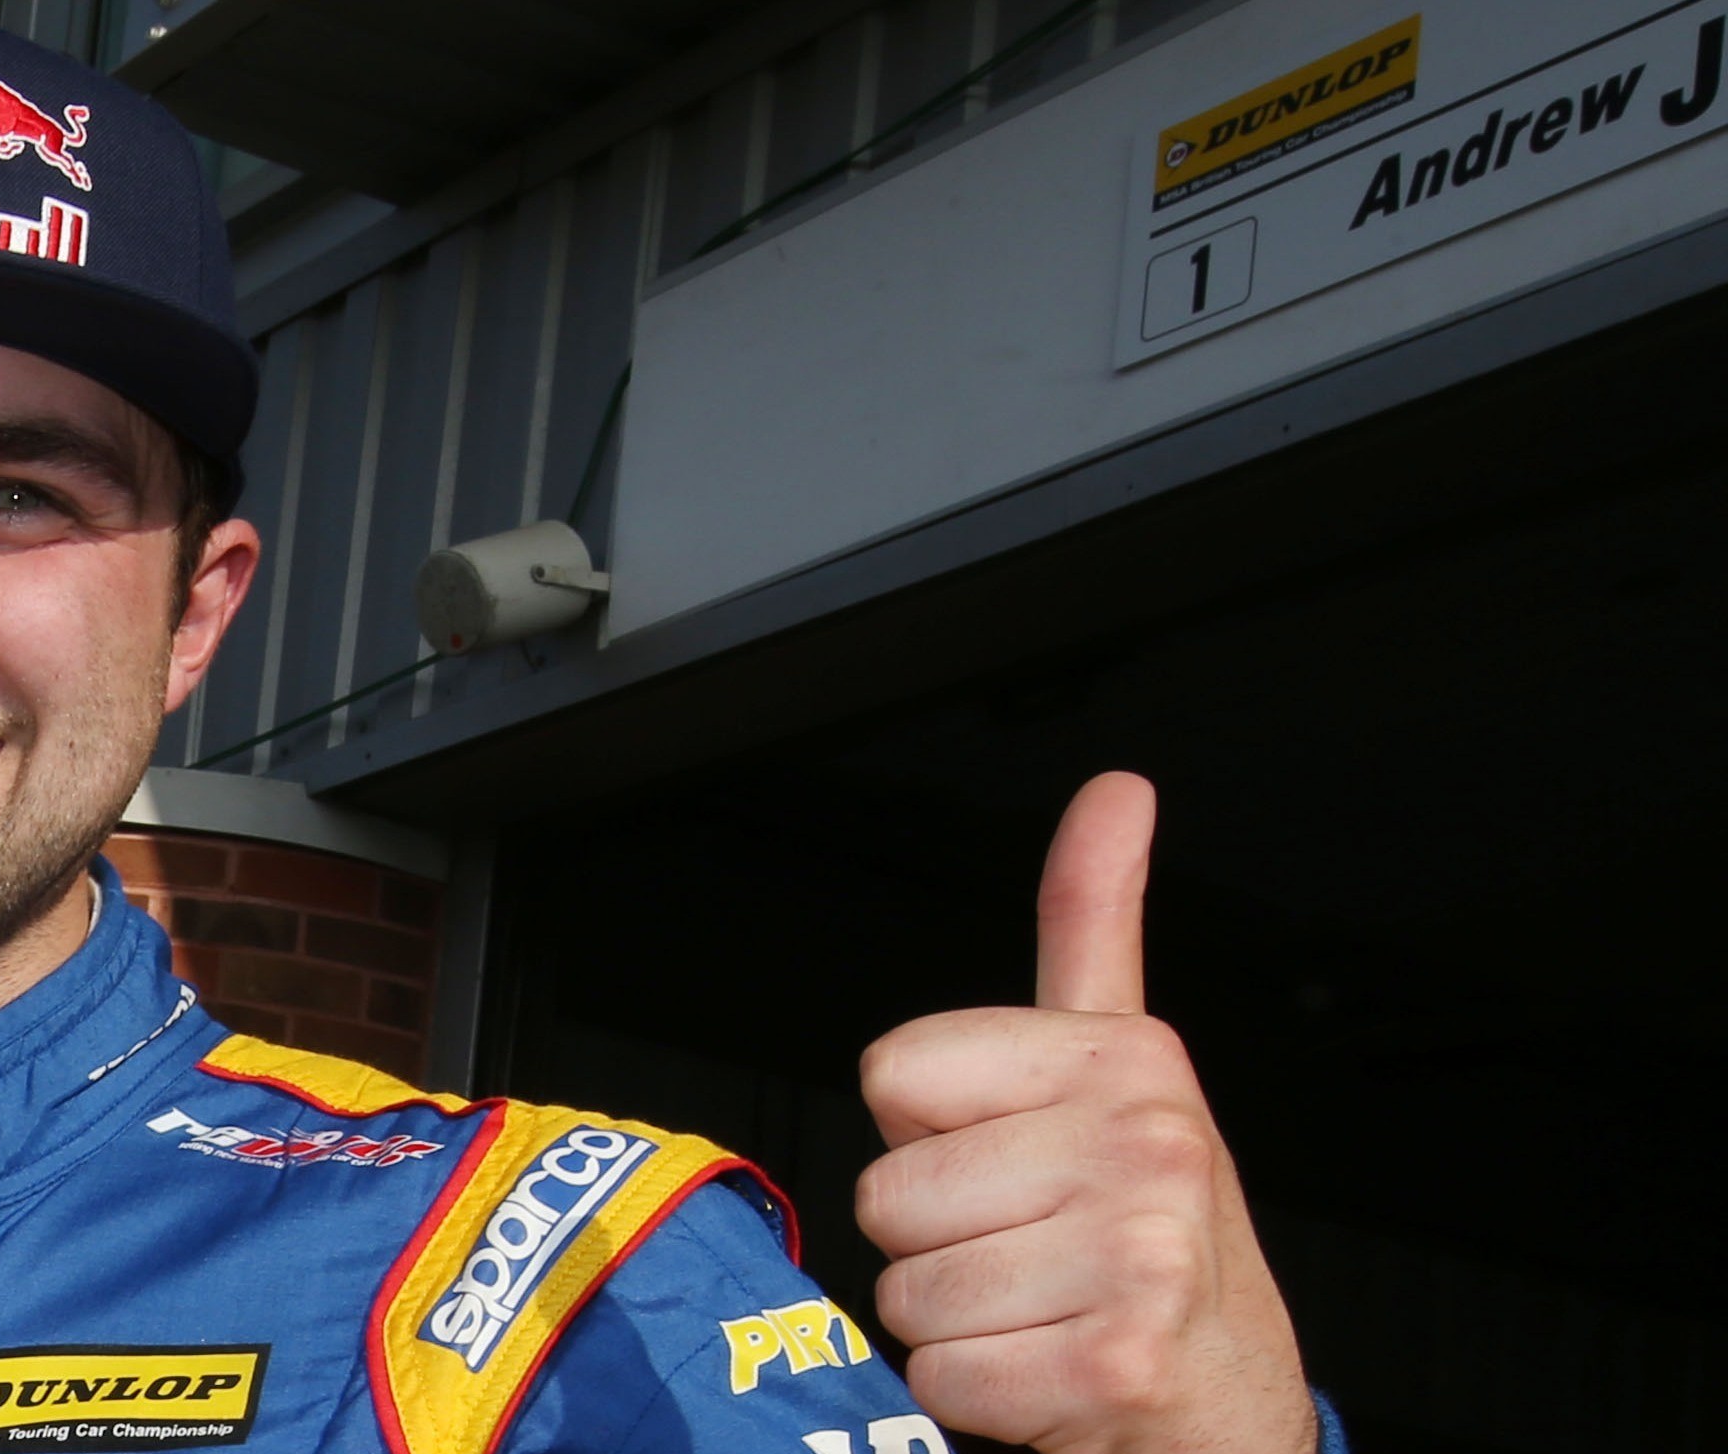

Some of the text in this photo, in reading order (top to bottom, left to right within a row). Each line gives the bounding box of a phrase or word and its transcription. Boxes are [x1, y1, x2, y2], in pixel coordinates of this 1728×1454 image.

[1200, 36, 1414, 153] DUNLOP
[1348, 63, 1647, 231] Andrew
[1190, 243, 1212, 315] 1
[430, 1126, 627, 1352] sparco
[7, 1424, 70, 1442] Touring
[75, 1422, 108, 1438] Car
[112, 1422, 234, 1440] Championship
